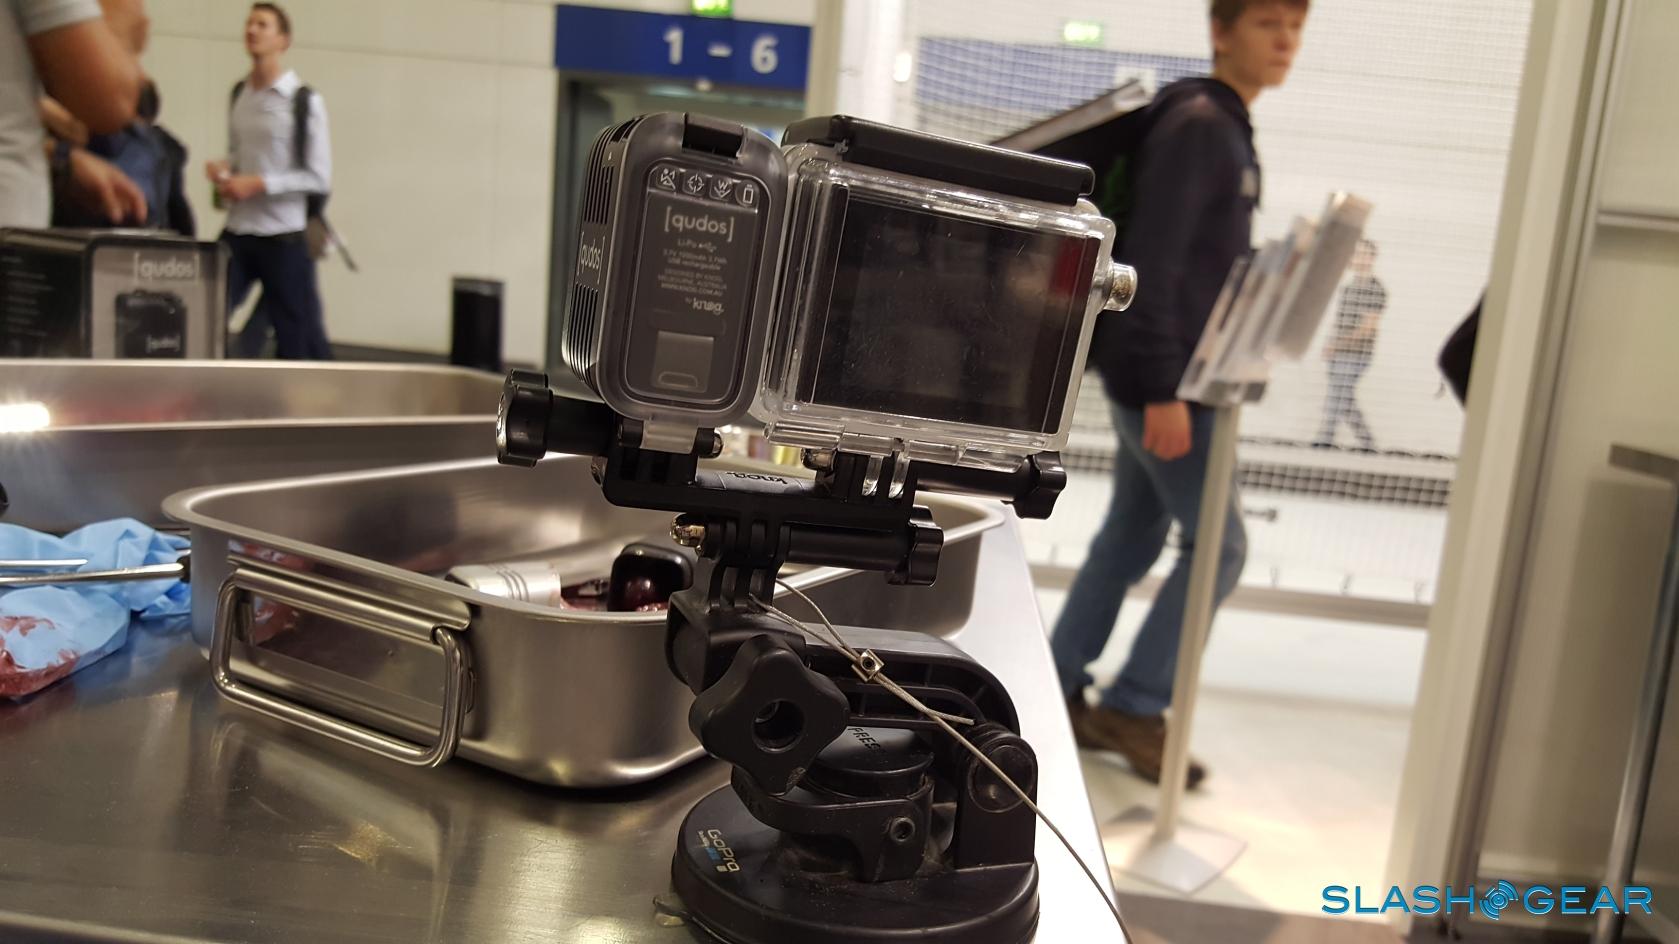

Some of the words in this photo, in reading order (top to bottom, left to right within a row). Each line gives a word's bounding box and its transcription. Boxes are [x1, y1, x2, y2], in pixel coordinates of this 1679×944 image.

[664, 25, 684, 65] 1
[752, 34, 779, 74] 6
[707, 829, 741, 872] GoPro
